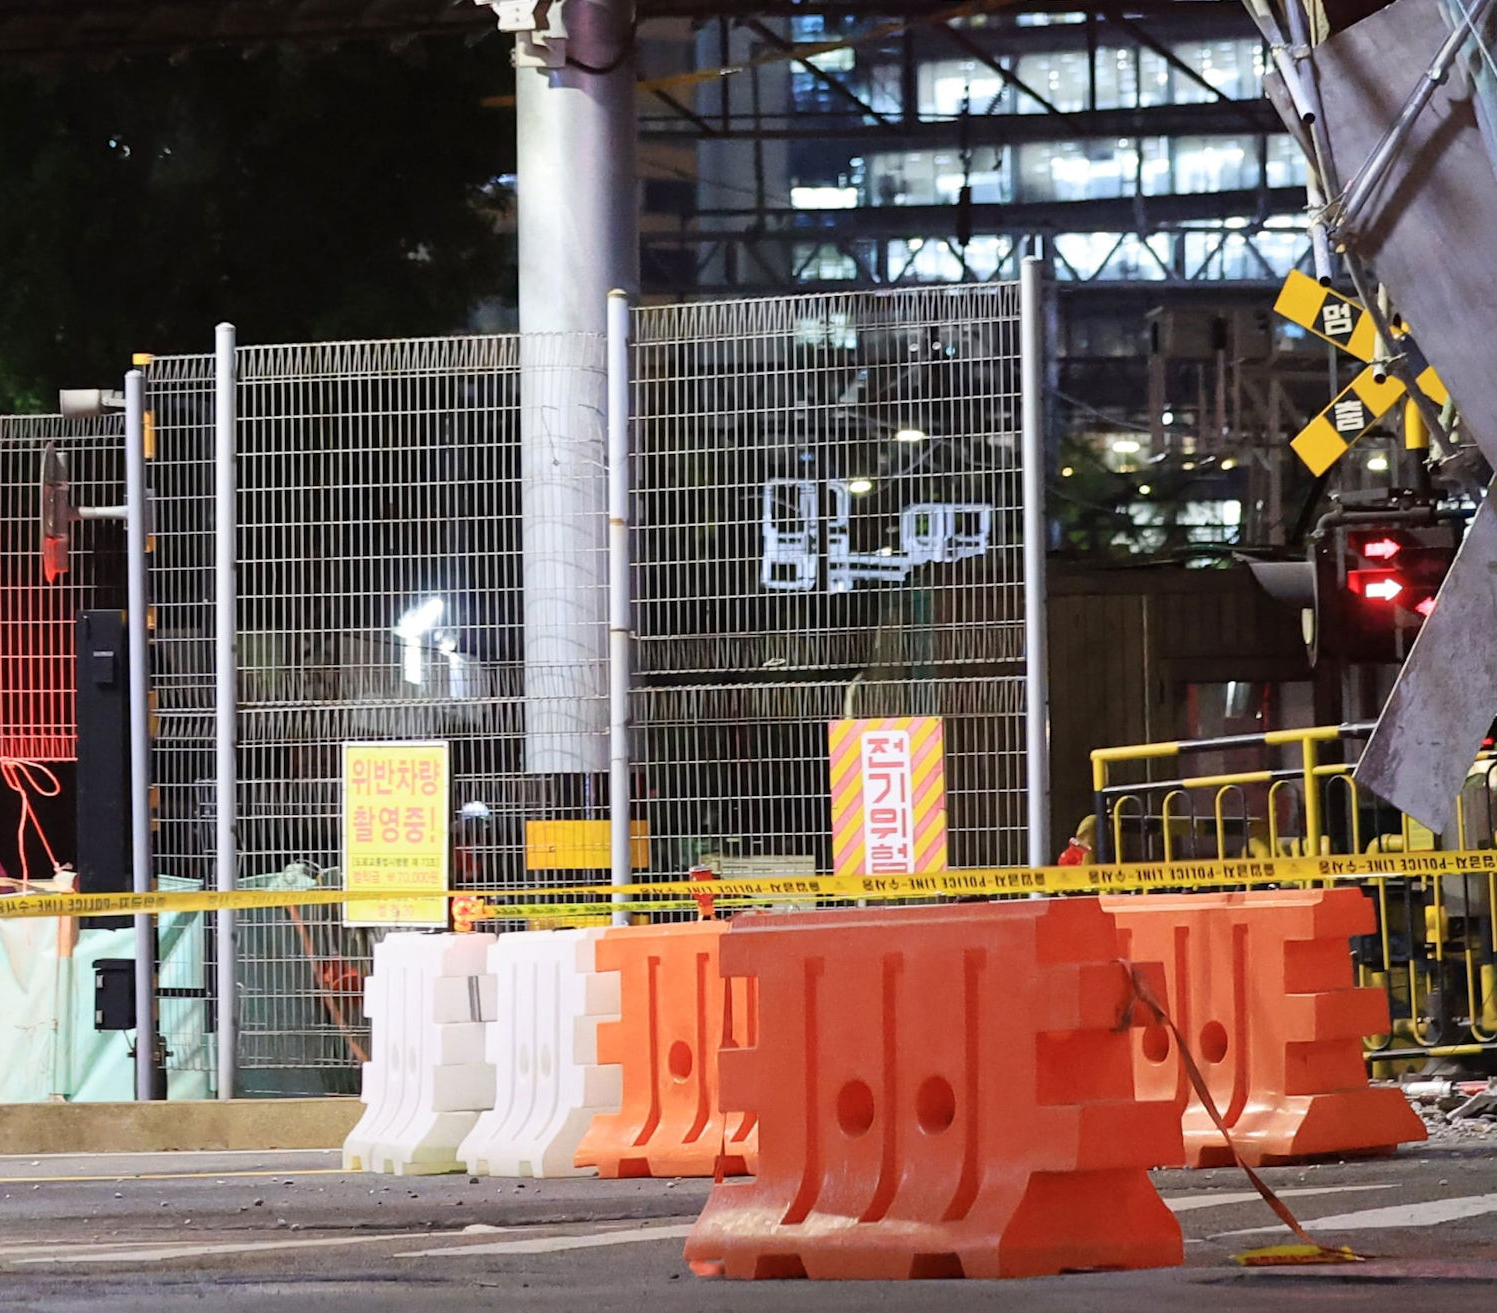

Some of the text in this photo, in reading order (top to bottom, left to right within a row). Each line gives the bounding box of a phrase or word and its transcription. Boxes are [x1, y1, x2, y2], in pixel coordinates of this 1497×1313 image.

[352, 758, 440, 796] 위반차량
[353, 805, 436, 844] 촬영중!
[867, 737, 908, 874] 전기위험
